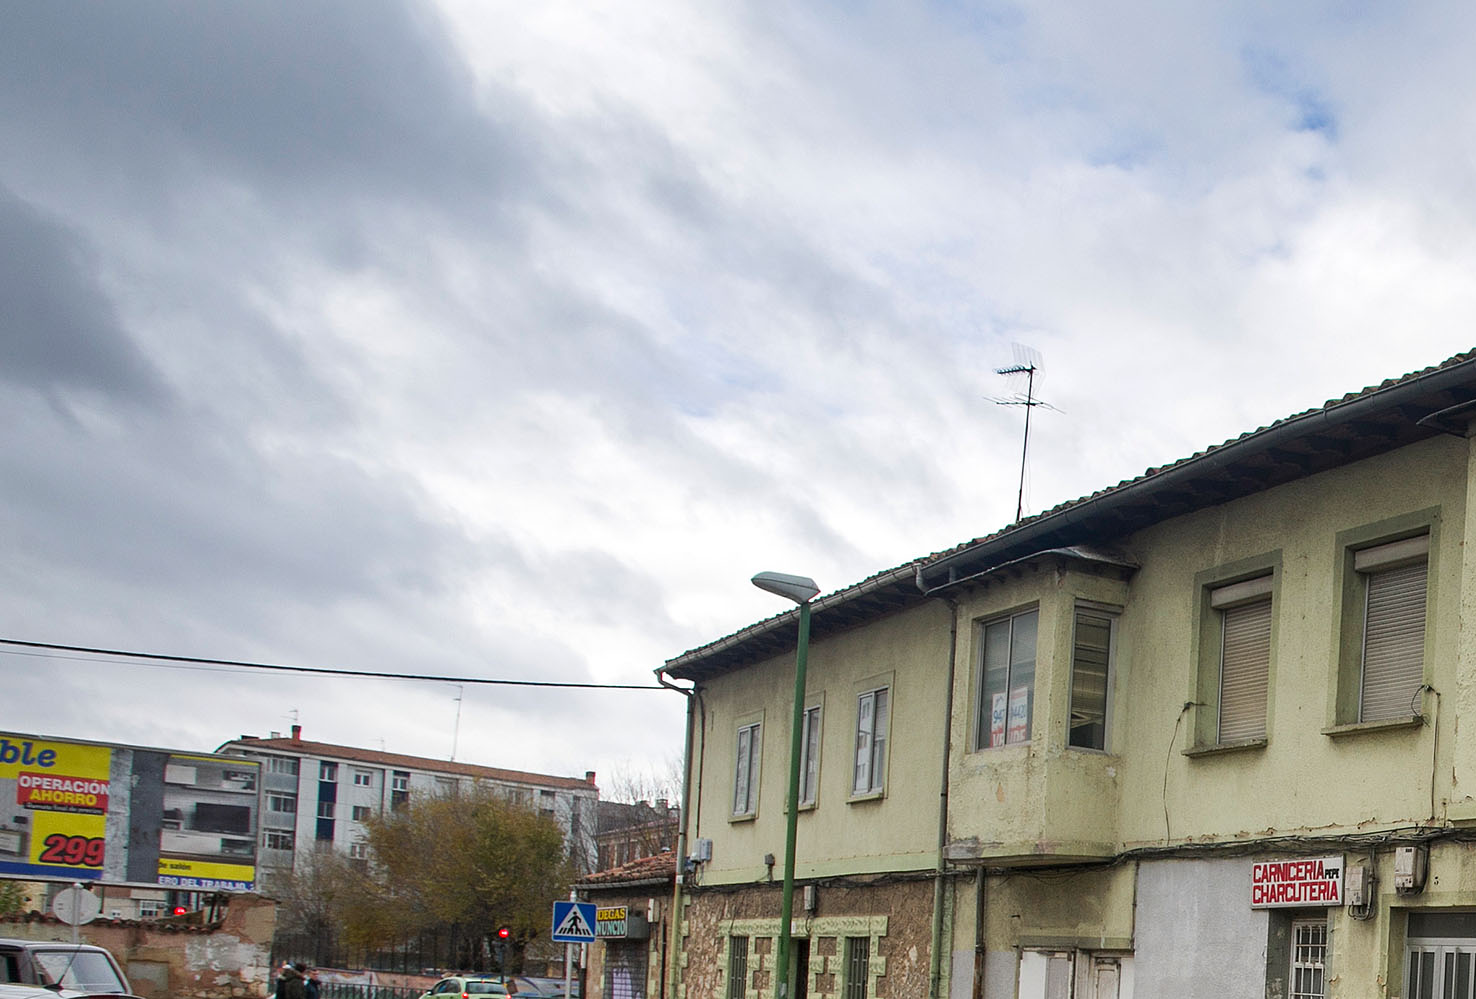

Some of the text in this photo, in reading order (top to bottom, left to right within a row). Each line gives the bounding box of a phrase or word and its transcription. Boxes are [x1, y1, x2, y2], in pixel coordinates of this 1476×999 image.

[0, 739, 57, 768] ble
[19, 775, 110, 795] OPERACIÓN
[30, 789, 97, 806] AHORRO
[39, 833, 105, 867] 299
[181, 878, 199, 887] DEL
[1253, 860, 1339, 884] CARNICERIA PEPE
[1252, 881, 1339, 905] CHARCUTERIA
